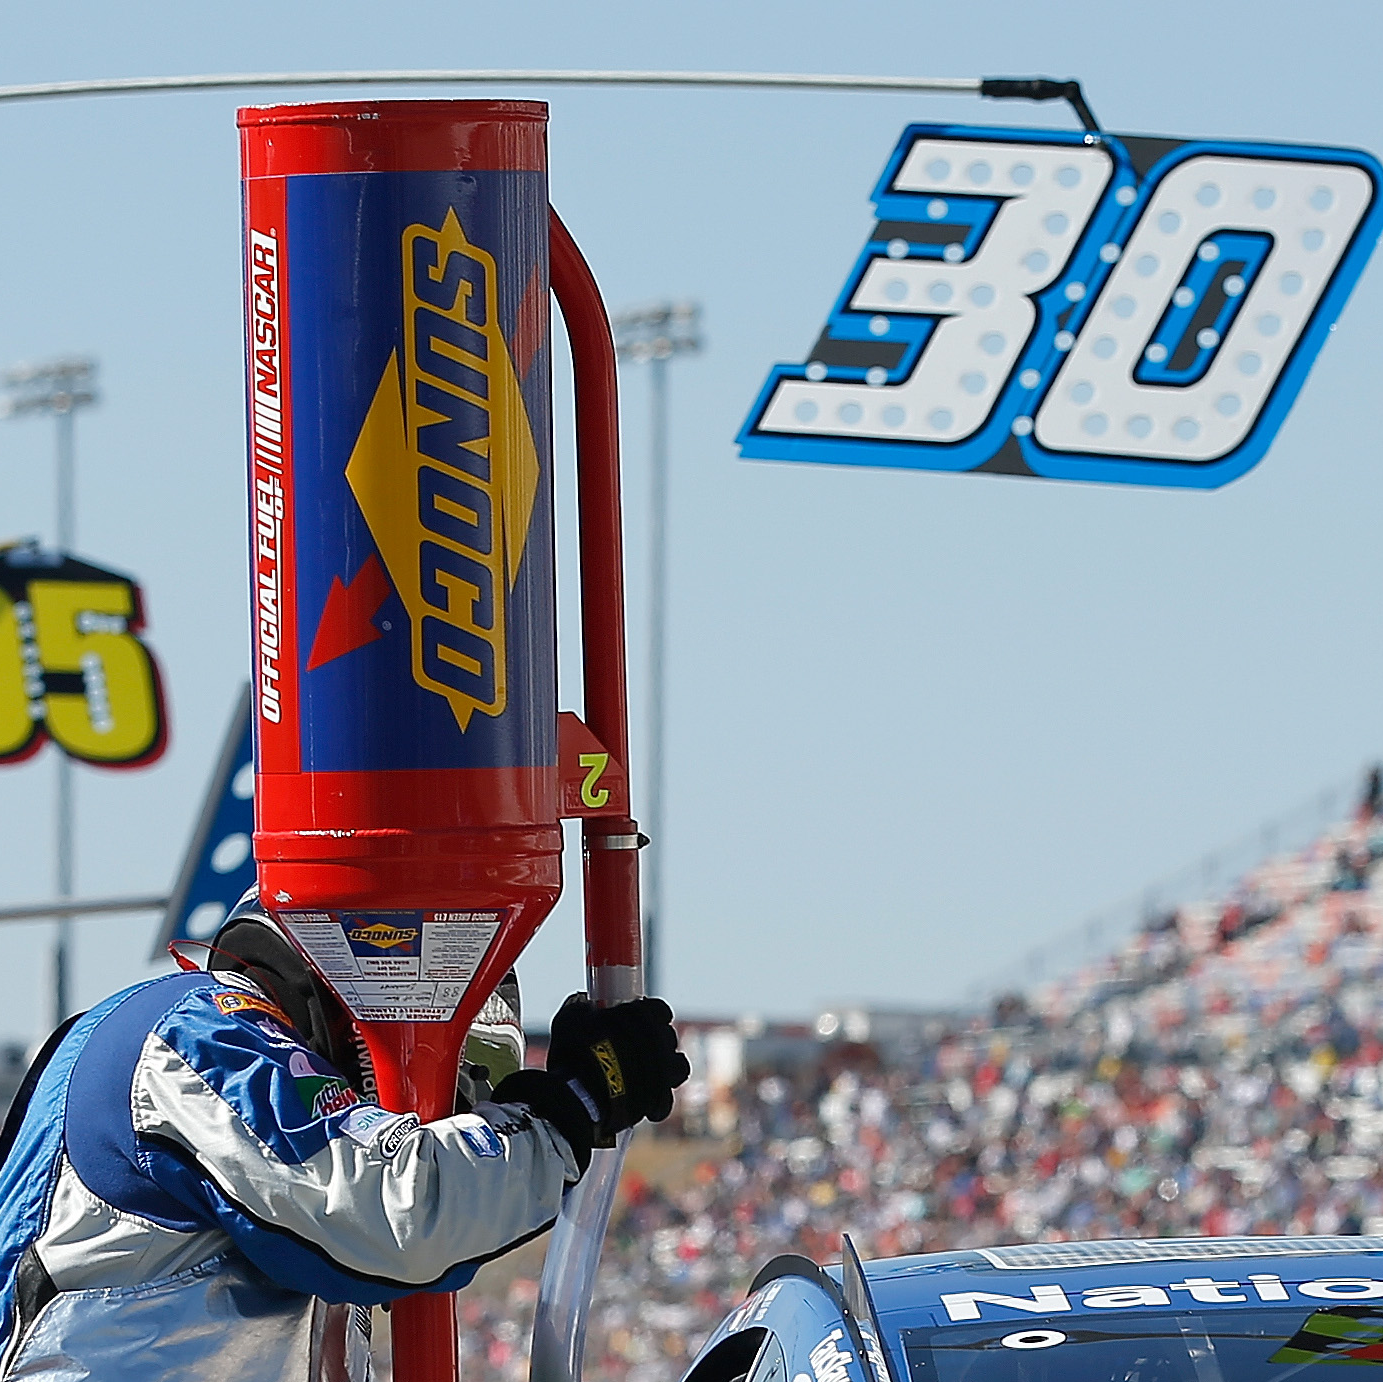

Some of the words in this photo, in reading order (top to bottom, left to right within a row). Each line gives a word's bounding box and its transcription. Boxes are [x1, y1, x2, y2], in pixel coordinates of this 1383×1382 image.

[251, 229, 281, 398] NASCAR
[748, 134, 1383, 470] 30
[255, 476, 280, 562] FUEL
[273, 478, 285, 520] OF
[408, 227, 498, 702] SUNOCO
[258, 558, 281, 725] OFFICIAL
[578, 752, 611, 809] 2
[349, 928, 415, 941] SUNOCO
